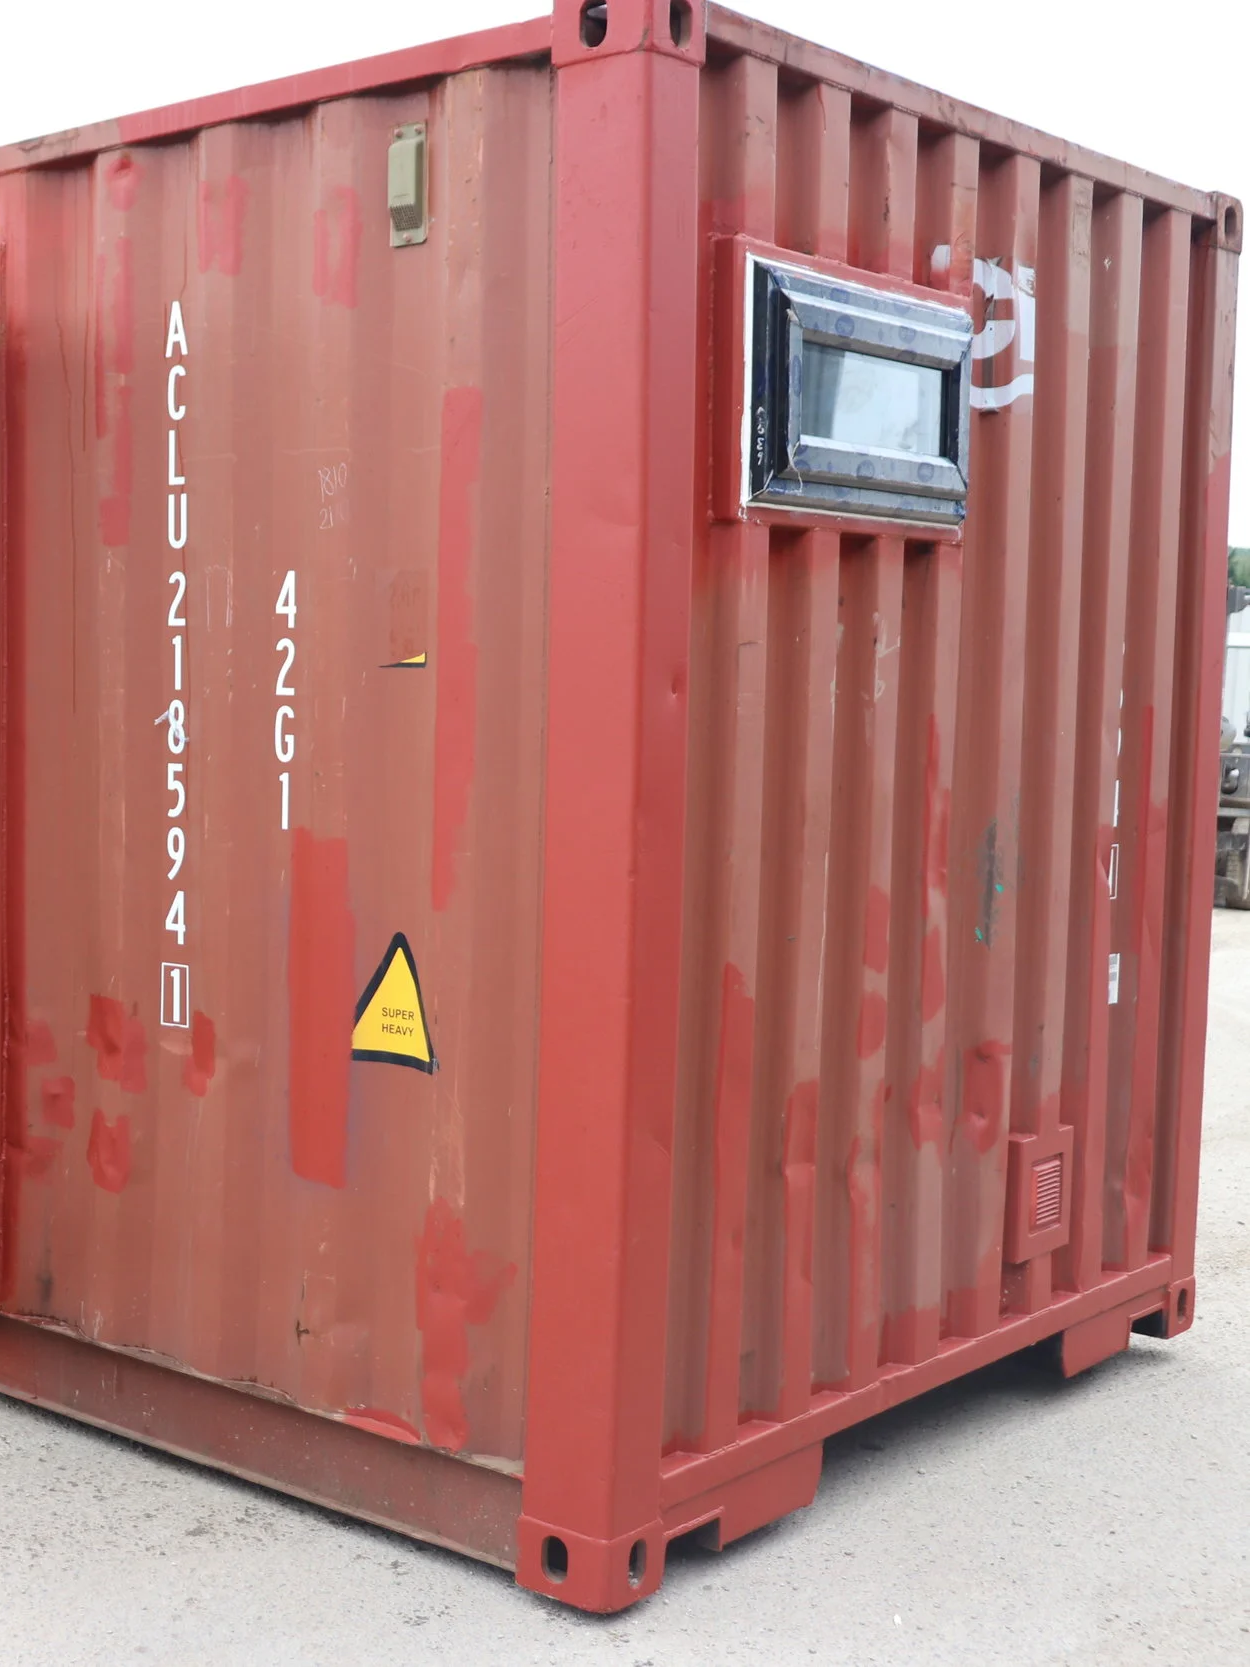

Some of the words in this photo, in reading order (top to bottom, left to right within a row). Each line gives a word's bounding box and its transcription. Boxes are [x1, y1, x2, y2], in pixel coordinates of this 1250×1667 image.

[165, 301, 188, 549] ACLU
[165, 571, 188, 945] 218594
[274, 570, 297, 830] 42G1
[381, 1006, 415, 1021] SUPER
[381, 1022, 415, 1038] HEAVY
